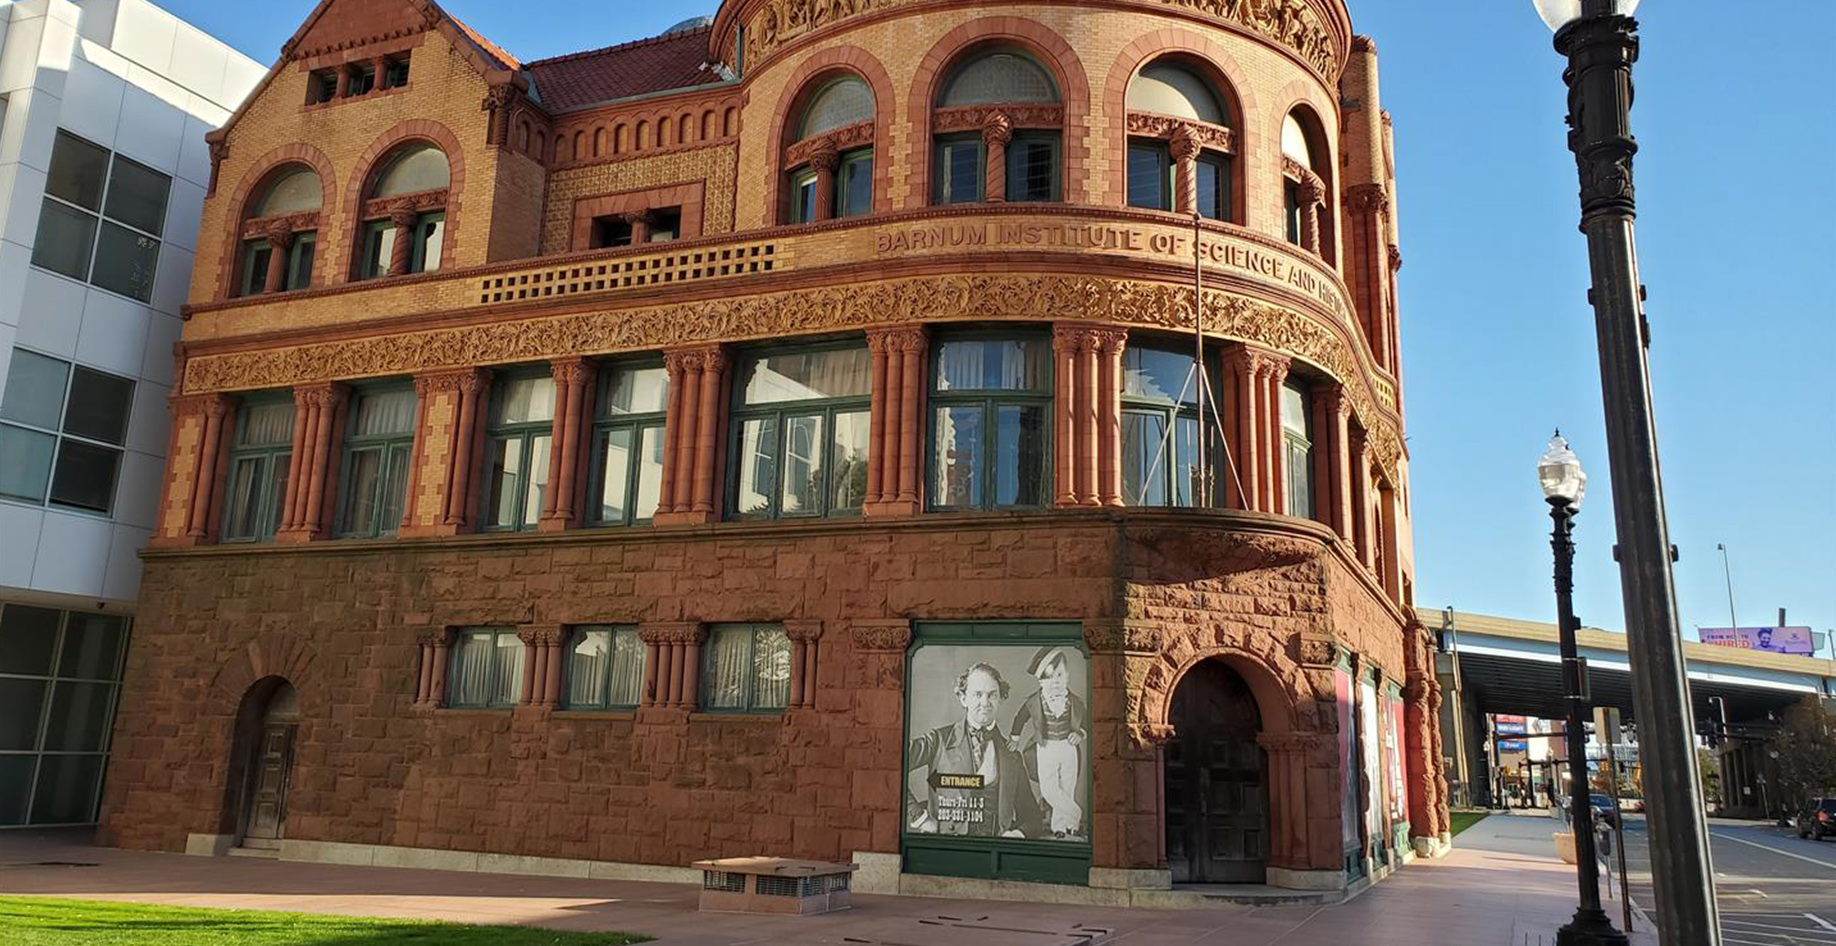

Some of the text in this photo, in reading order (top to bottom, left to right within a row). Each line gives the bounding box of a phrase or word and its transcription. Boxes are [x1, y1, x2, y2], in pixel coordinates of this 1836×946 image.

[876, 224, 987, 252] BARNUM
[997, 223, 1144, 250] INSTITUTE
[1150, 232, 1186, 255] OF
[1192, 241, 1284, 281] SCIENCE
[1287, 265, 1316, 293] AND
[941, 776, 980, 787] ENTRANCE
